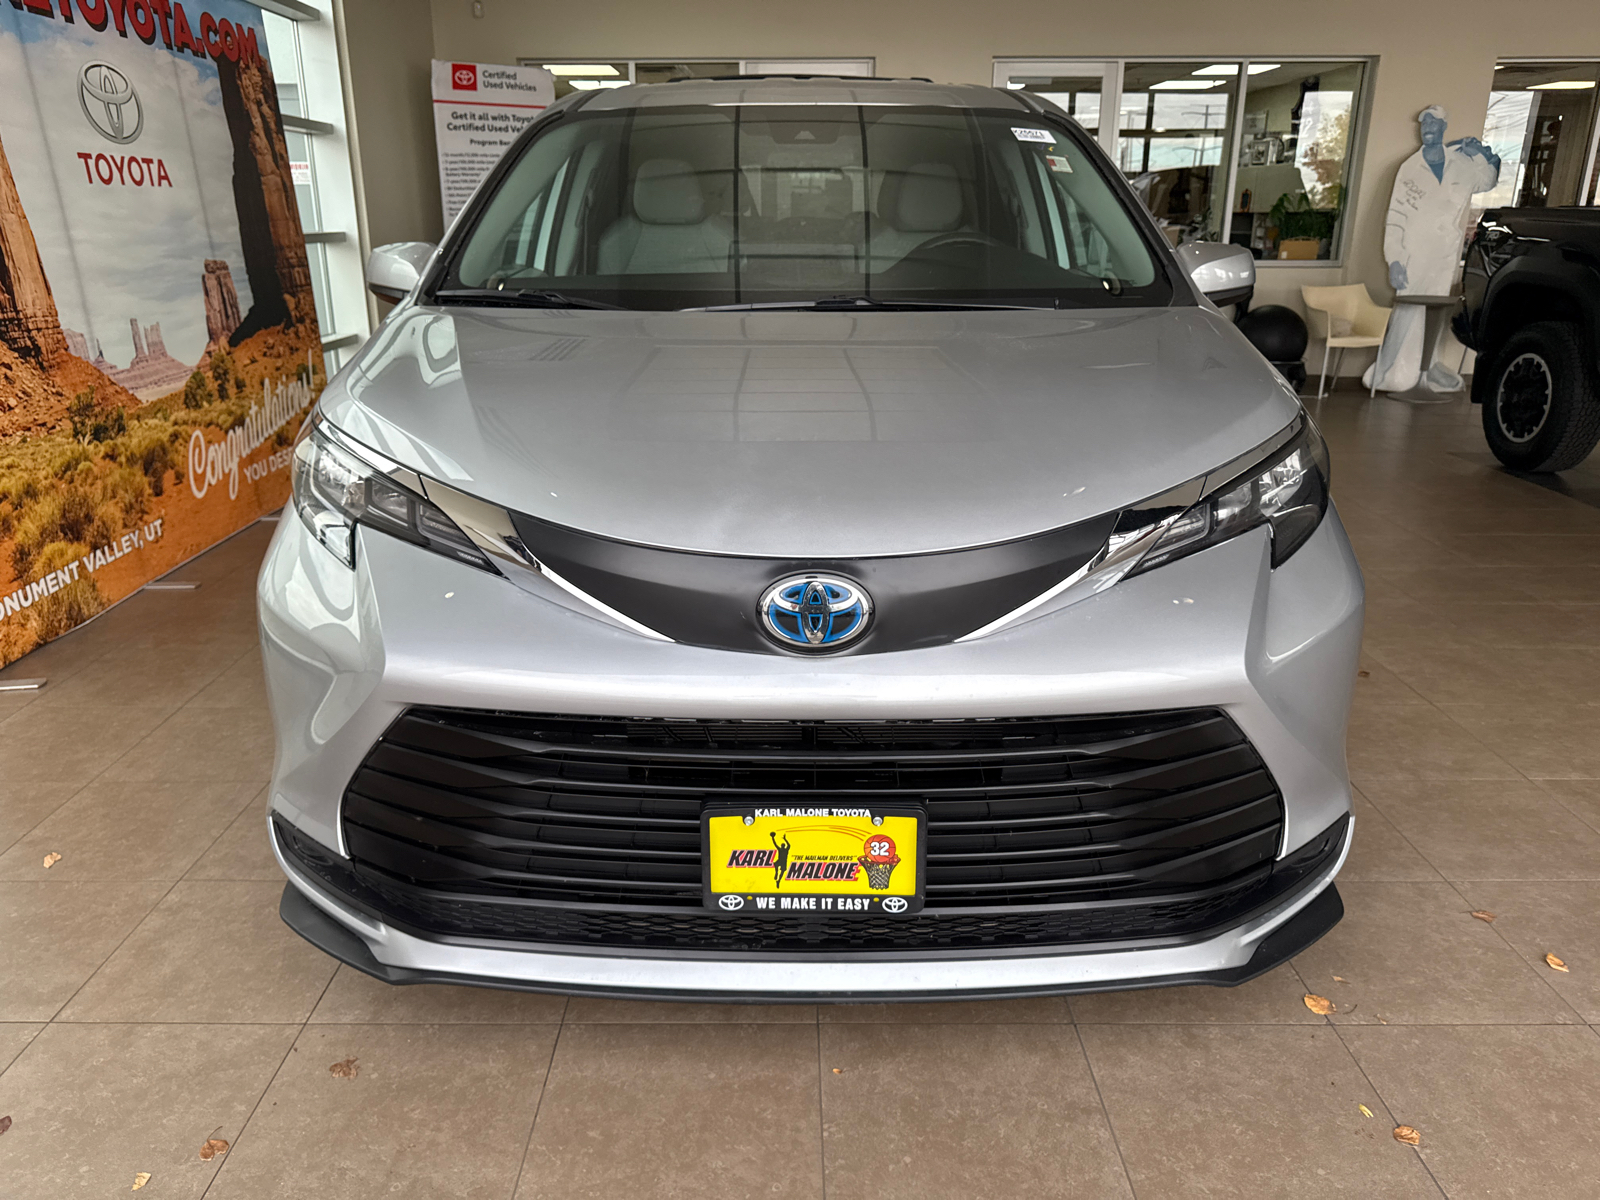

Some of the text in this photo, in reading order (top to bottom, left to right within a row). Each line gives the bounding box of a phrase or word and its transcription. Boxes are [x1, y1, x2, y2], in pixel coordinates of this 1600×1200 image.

[482, 70, 517, 80] Certified
[483, 80, 537, 92] Used Vehicles
[451, 111, 468, 120] Get
[469, 112, 476, 120] it
[478, 113, 489, 121] all
[490, 113, 510, 122] with
[447, 122, 486, 132] Certified
[487, 125, 509, 133] Used
[470, 138, 498, 146] Program
[77, 152, 173, 188] TOYOTA
[243, 459, 268, 484] YOU
[83, 529, 144, 574] VALLEY,
[144, 518, 163, 542] UT
[754, 808, 871, 818] KARL MALONE TOYOTA
[870, 841, 890, 856] 32
[727, 849, 776, 868] KARL
[785, 862, 861, 881] MALONE
[756, 897, 870, 910] WE MAKE IT EASY
